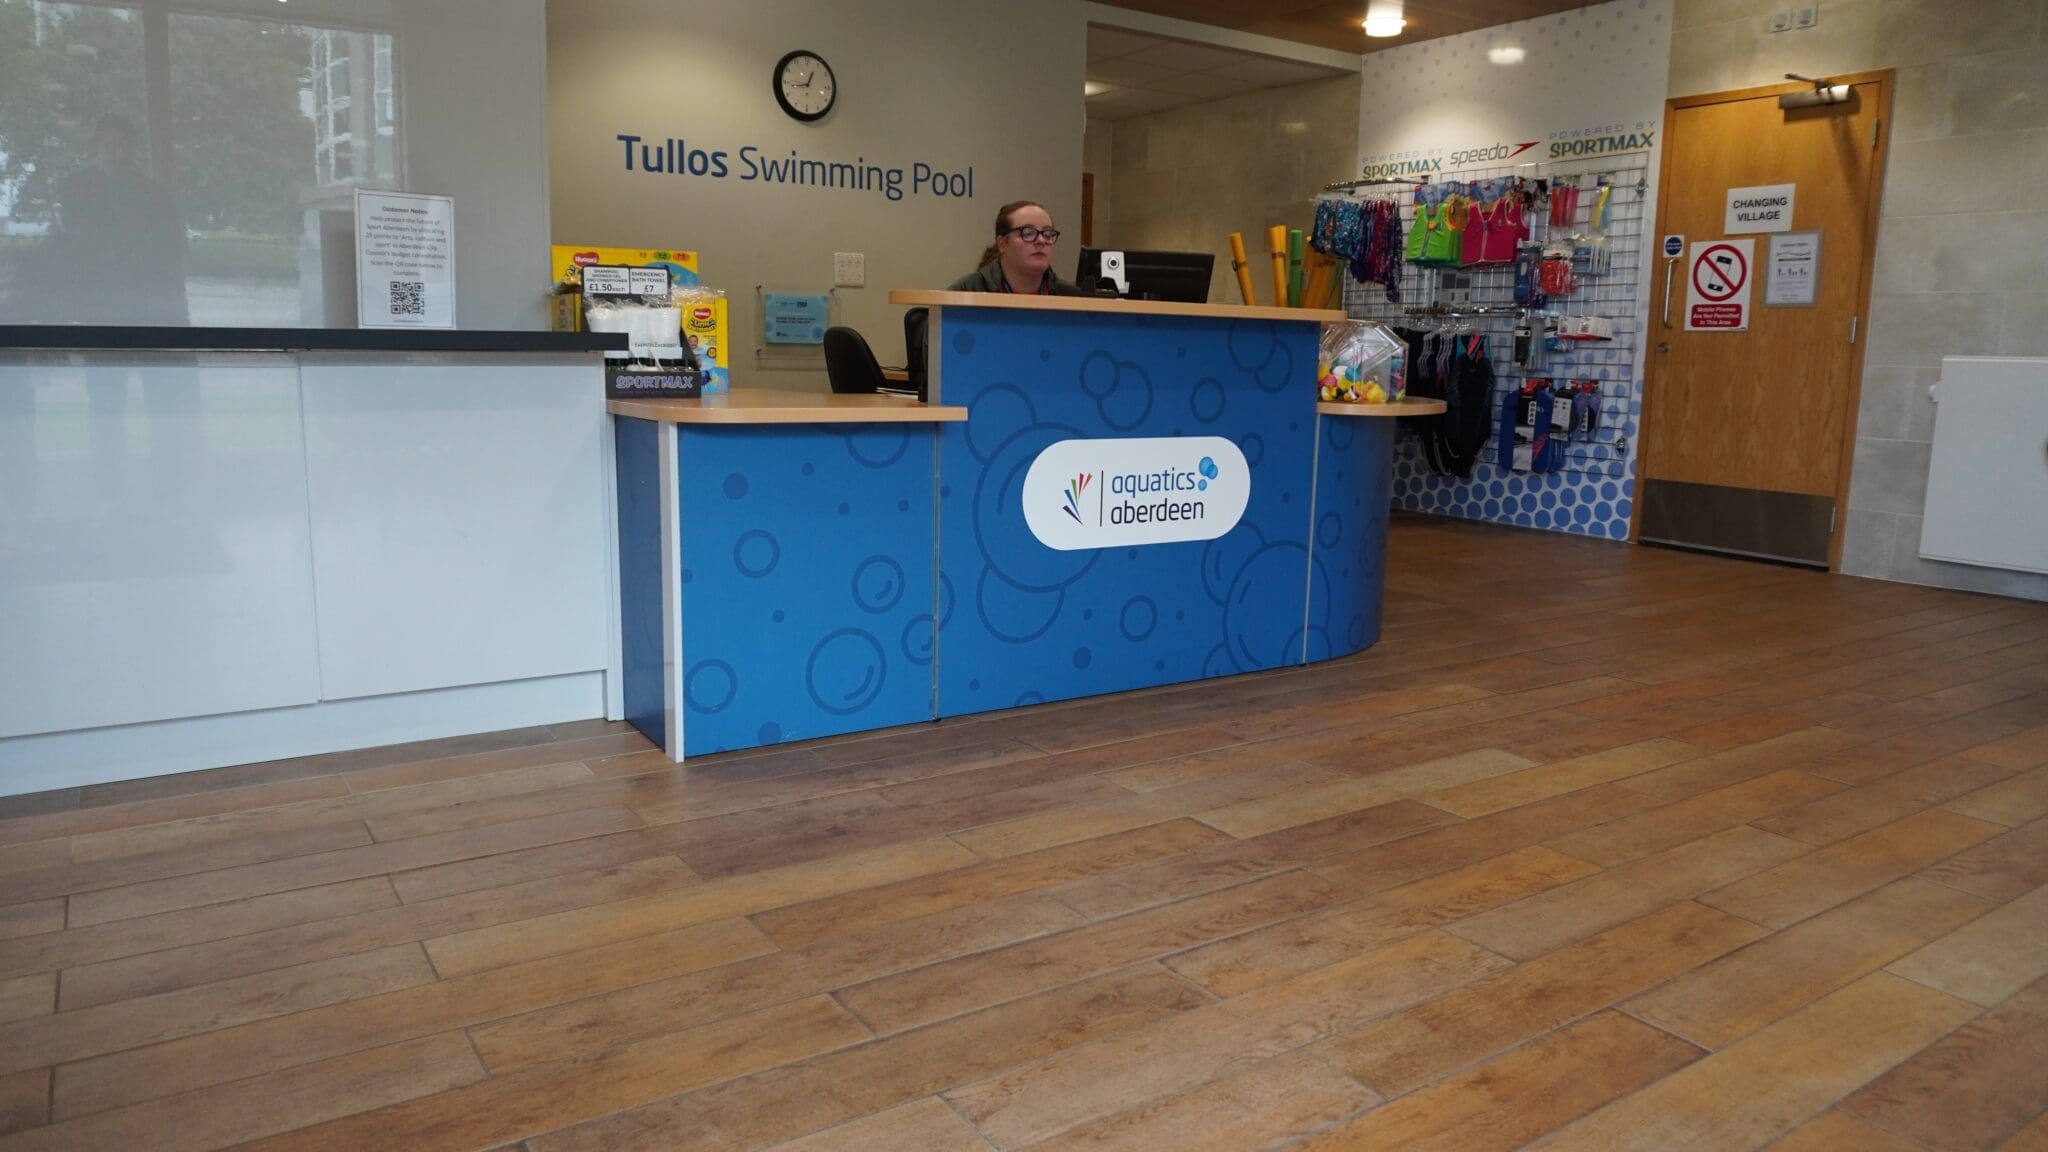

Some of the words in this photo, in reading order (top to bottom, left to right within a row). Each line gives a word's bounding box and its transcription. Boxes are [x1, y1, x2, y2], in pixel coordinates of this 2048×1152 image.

[1548, 124, 1624, 139] POWERED
[1635, 120, 1656, 130] BY
[1549, 131, 1654, 158] SPORTMAX
[1450, 142, 1508, 168] speedo
[617, 134, 728, 178] Tullos
[739, 146, 903, 201] Swimming
[913, 163, 973, 198] Pool
[1362, 157, 1442, 179] SPORTMAX
[382, 206, 410, 214] Customer
[1733, 196, 1788, 208] CHANGING
[1737, 210, 1780, 222] VILLAGE
[644, 284, 654, 292] £7
[616, 375, 693, 389] SPORTMAX
[1112, 467, 1195, 498] aquatics
[1111, 498, 1204, 524] aberdeen
